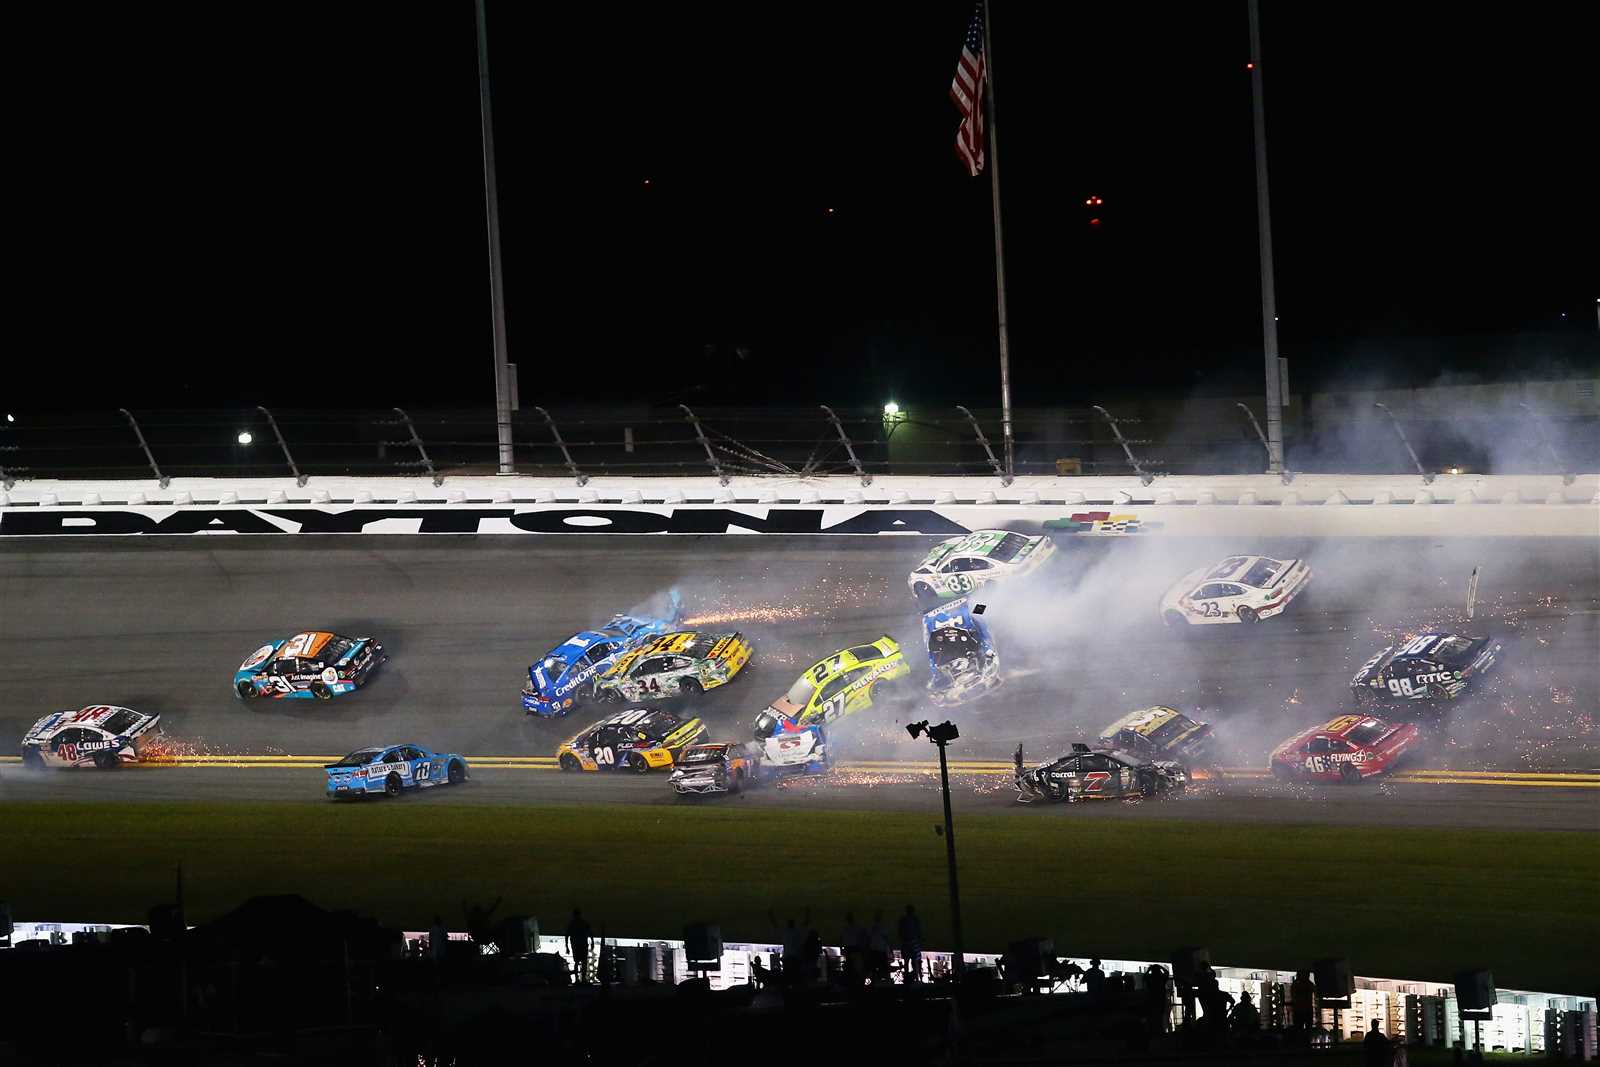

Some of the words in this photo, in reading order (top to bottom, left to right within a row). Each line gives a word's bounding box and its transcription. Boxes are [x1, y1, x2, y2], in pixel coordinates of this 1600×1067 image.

[0, 508, 973, 535] DAYTONA
[948, 573, 973, 594] 83
[1200, 602, 1222, 617] 23
[285, 633, 317, 657] 31
[813, 654, 841, 684] 27
[1416, 671, 1452, 684] RTIC
[268, 675, 298, 693] 31
[636, 677, 661, 695] 34
[1388, 677, 1415, 697] 98
[71, 705, 110, 723] 48
[822, 692, 846, 724] 27
[606, 709, 648, 726] 20
[57, 743, 77, 761] 48
[593, 746, 615, 765] 20
[1331, 753, 1358, 763] FLYING
[1305, 756, 1325, 773] 46
[1084, 771, 1112, 792] 7
